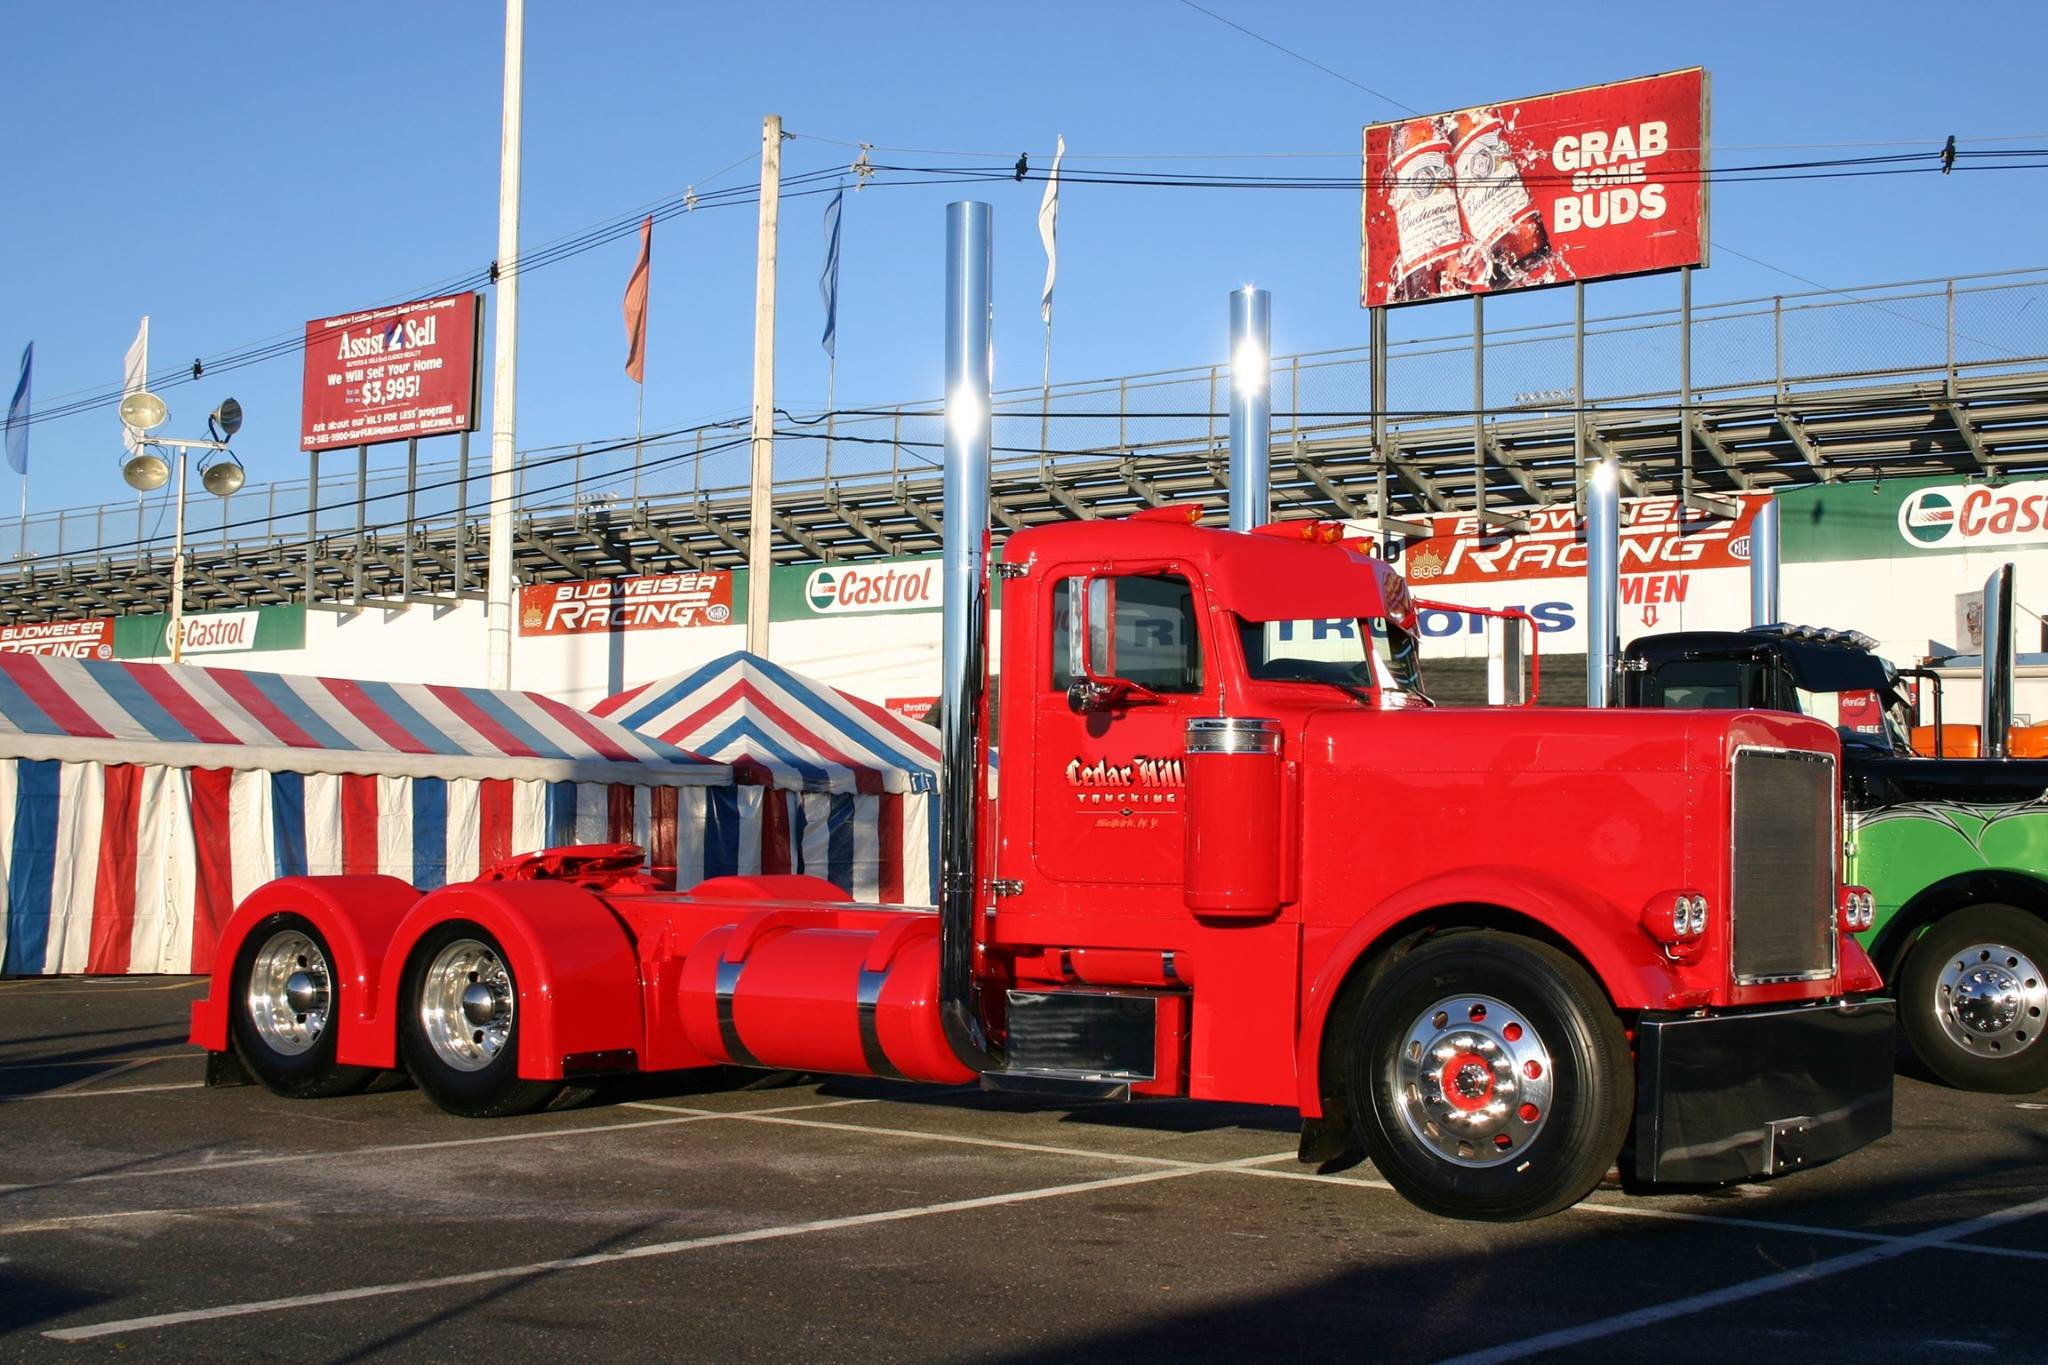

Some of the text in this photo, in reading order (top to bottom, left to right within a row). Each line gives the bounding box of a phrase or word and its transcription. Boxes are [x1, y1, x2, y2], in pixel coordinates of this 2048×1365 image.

[1552, 121, 1668, 171] GRAB
[1572, 161, 1647, 192] SOME
[1554, 183, 1667, 233] BUDS
[337, 315, 436, 360] Assist 2 Sell
[327, 357, 443, 386] We Will Sell Your Home
[362, 375, 421, 406] $3,995!
[1443, 532, 1729, 576] RACNG
[555, 575, 717, 601] BUDWEISER
[838, 566, 932, 606] Castrol
[1620, 574, 1690, 605] MEN
[1, 621, 105, 641] BUDWEISER
[545, 601, 709, 631] RACING
[186, 617, 246, 648] Castrol
[1065, 757, 1133, 787] Cedar
[1076, 792, 1176, 804] TRUCKING
